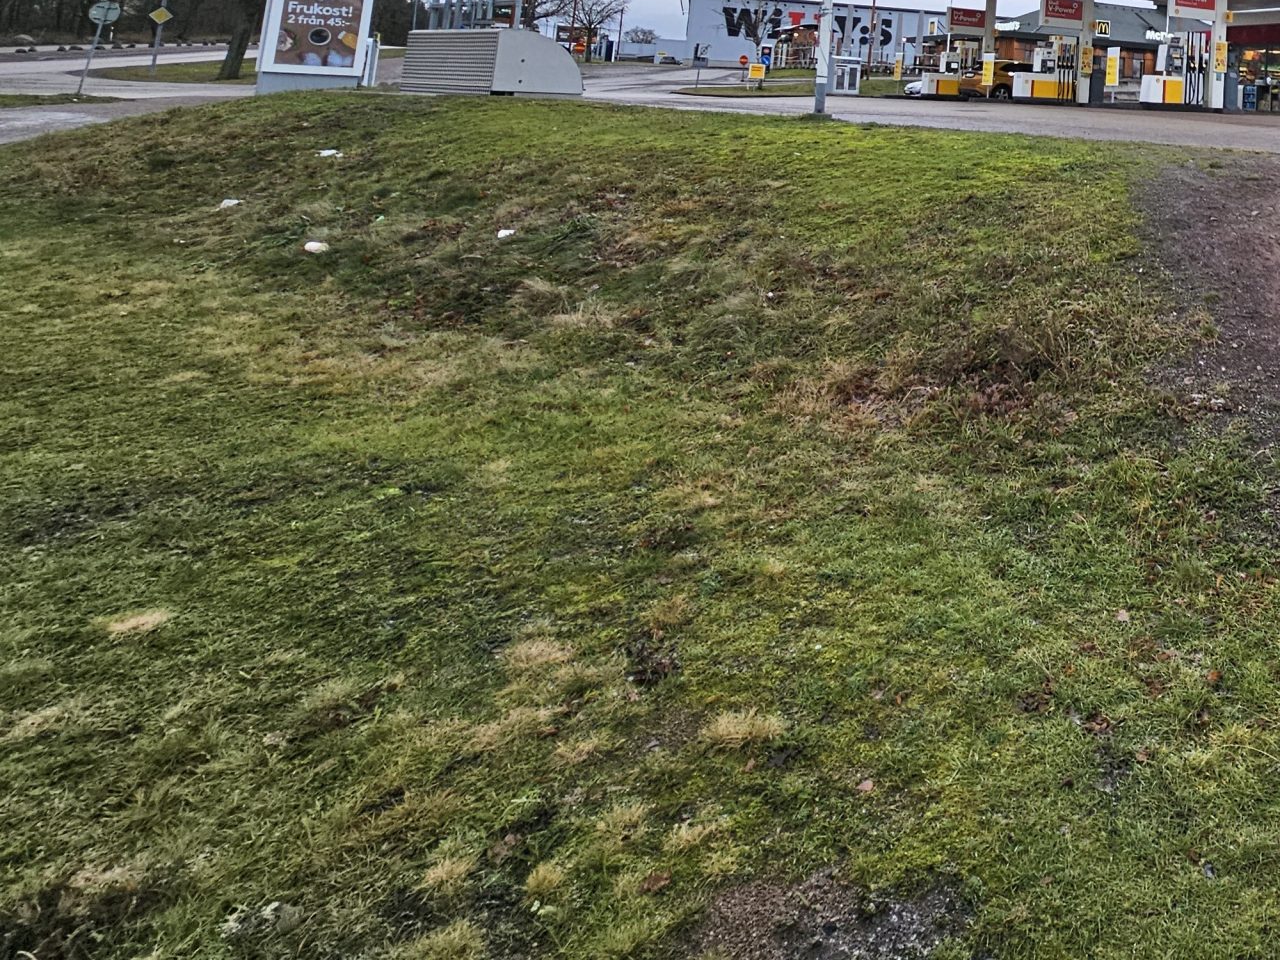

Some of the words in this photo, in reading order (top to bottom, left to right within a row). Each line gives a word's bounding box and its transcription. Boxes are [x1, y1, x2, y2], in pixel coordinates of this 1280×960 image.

[287, 0, 353, 17] Frukost!
[1048, 4, 1076, 14] V-Power
[287, 14, 296, 24] 2
[298, 15, 325, 26] från
[326, 17, 351, 27] 45:-
